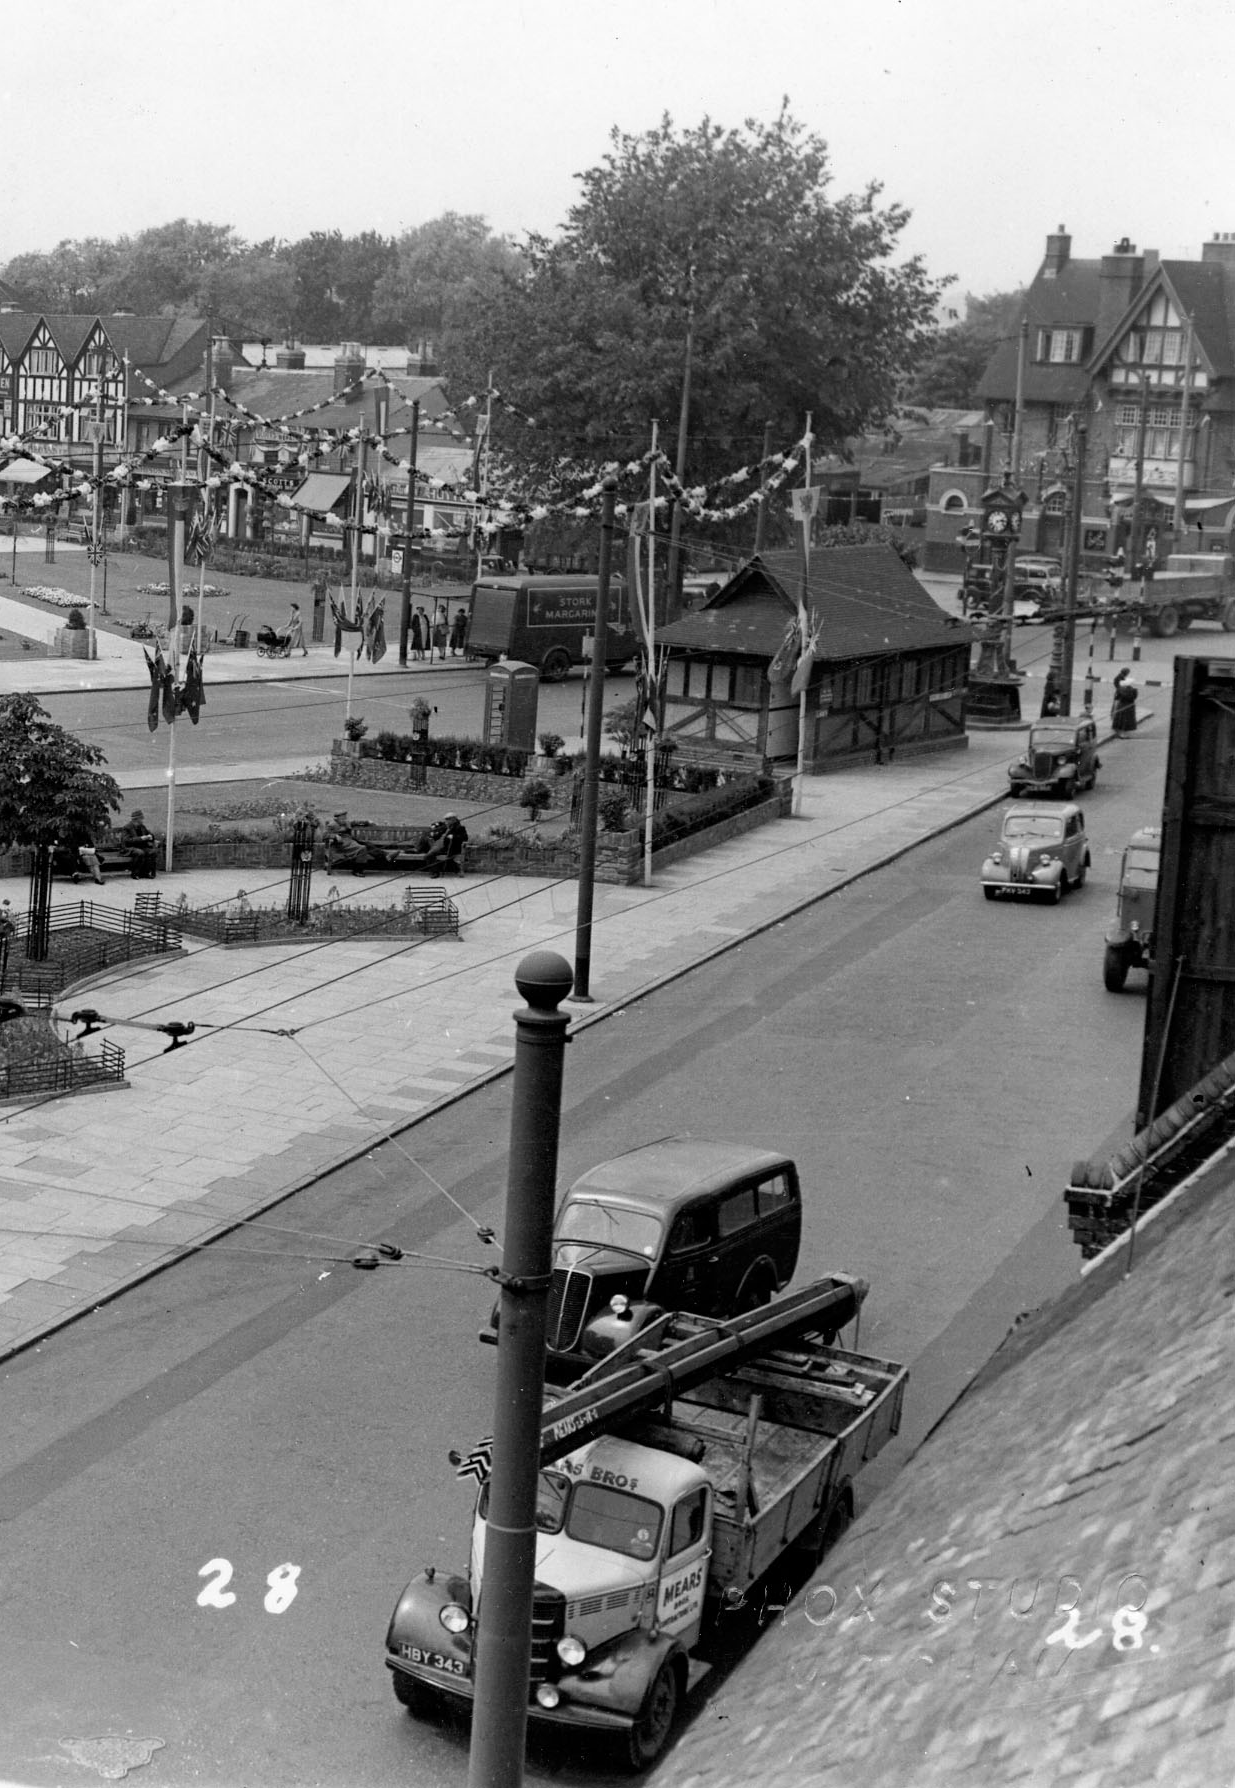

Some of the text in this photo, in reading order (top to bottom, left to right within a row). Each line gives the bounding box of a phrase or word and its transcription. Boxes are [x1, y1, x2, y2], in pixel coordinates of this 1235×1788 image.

[559, 597, 593, 608] STORK
[545, 609, 598, 619] MARGARIN
[663, 1567, 703, 1608] MEARS
[402, 1644, 464, 1674] HBY 343
